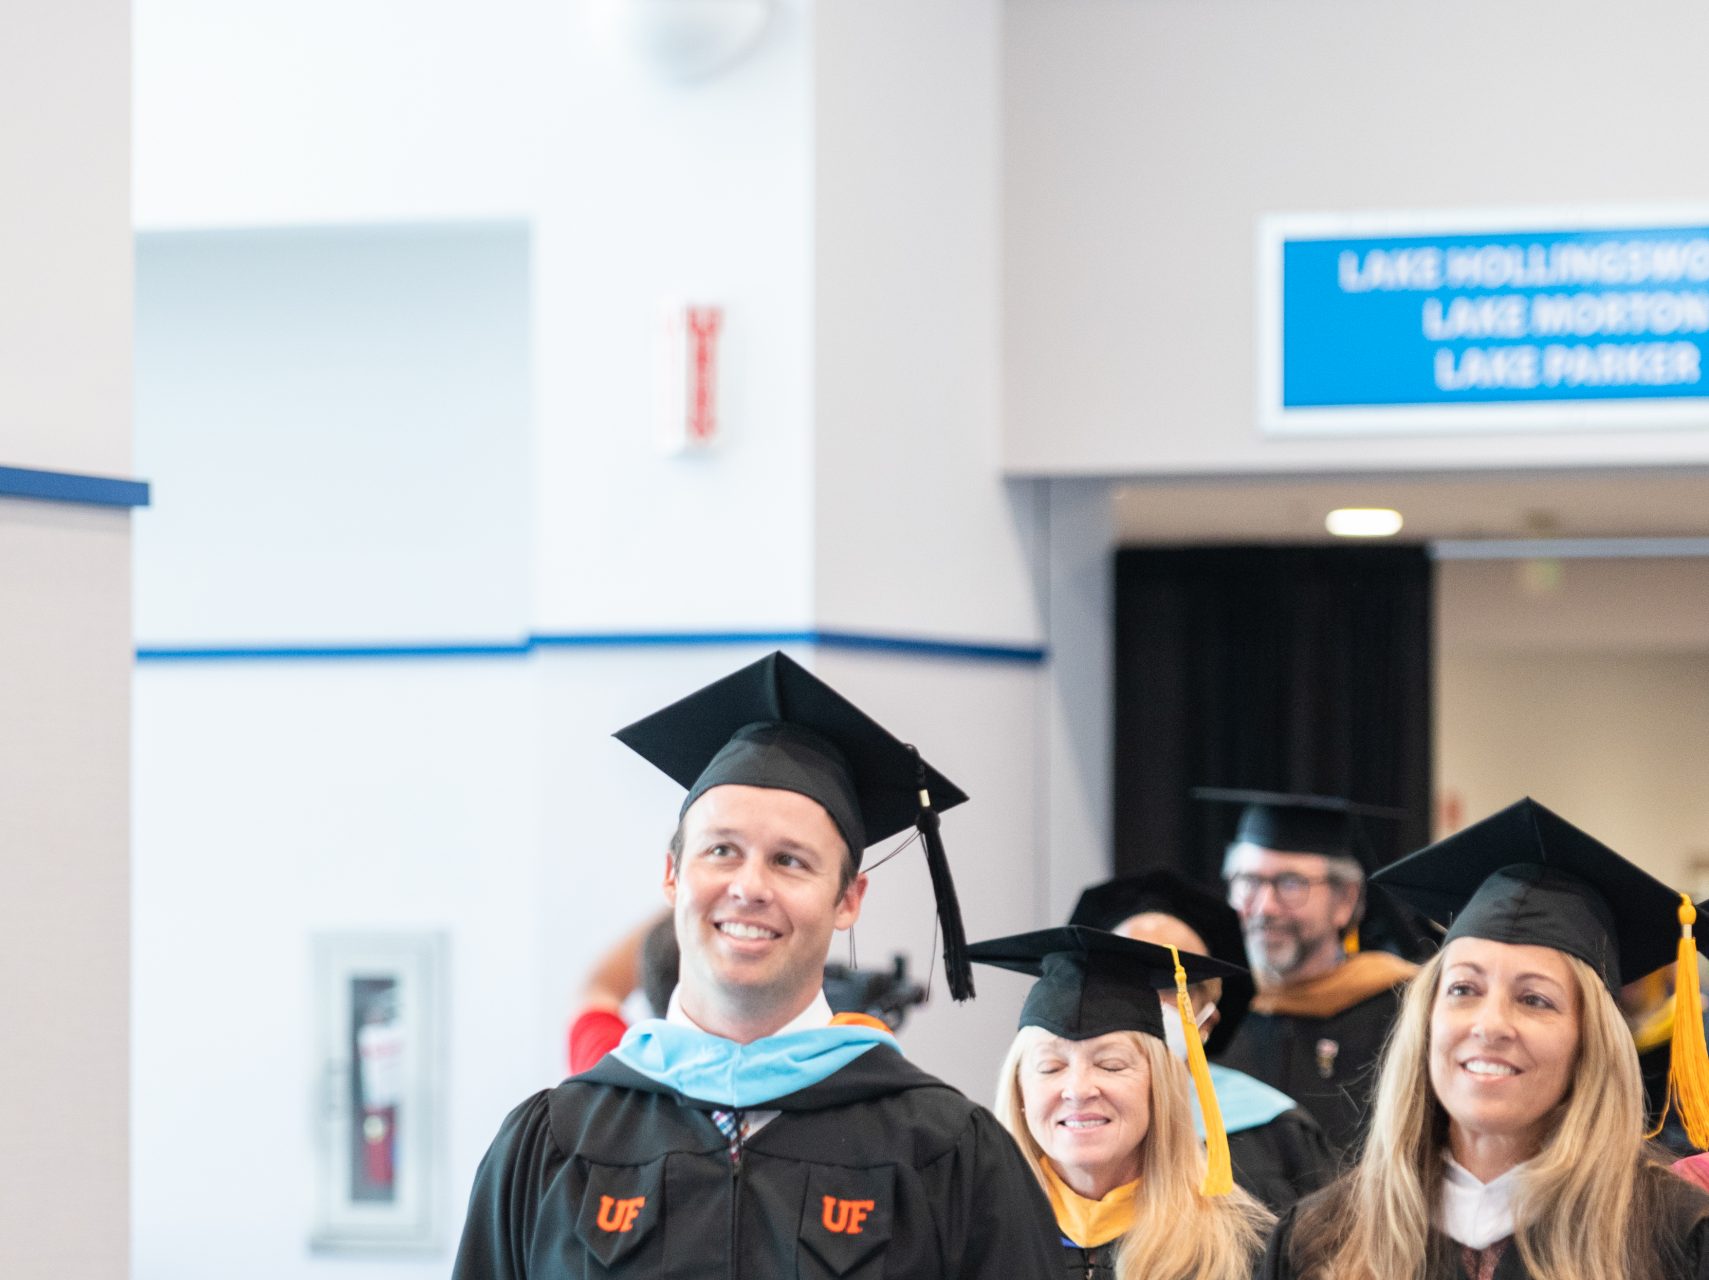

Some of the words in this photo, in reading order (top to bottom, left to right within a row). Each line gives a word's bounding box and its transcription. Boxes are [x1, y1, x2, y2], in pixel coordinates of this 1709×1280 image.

[1340, 247, 1442, 291] LAKE
[1423, 294, 1527, 339] LAKE
[1531, 290, 1709, 336] MORTON
[1434, 345, 1540, 390] LAKE
[1543, 341, 1701, 386] PARKER
[597, 1195, 645, 1232] UF
[822, 1195, 874, 1234] UF
